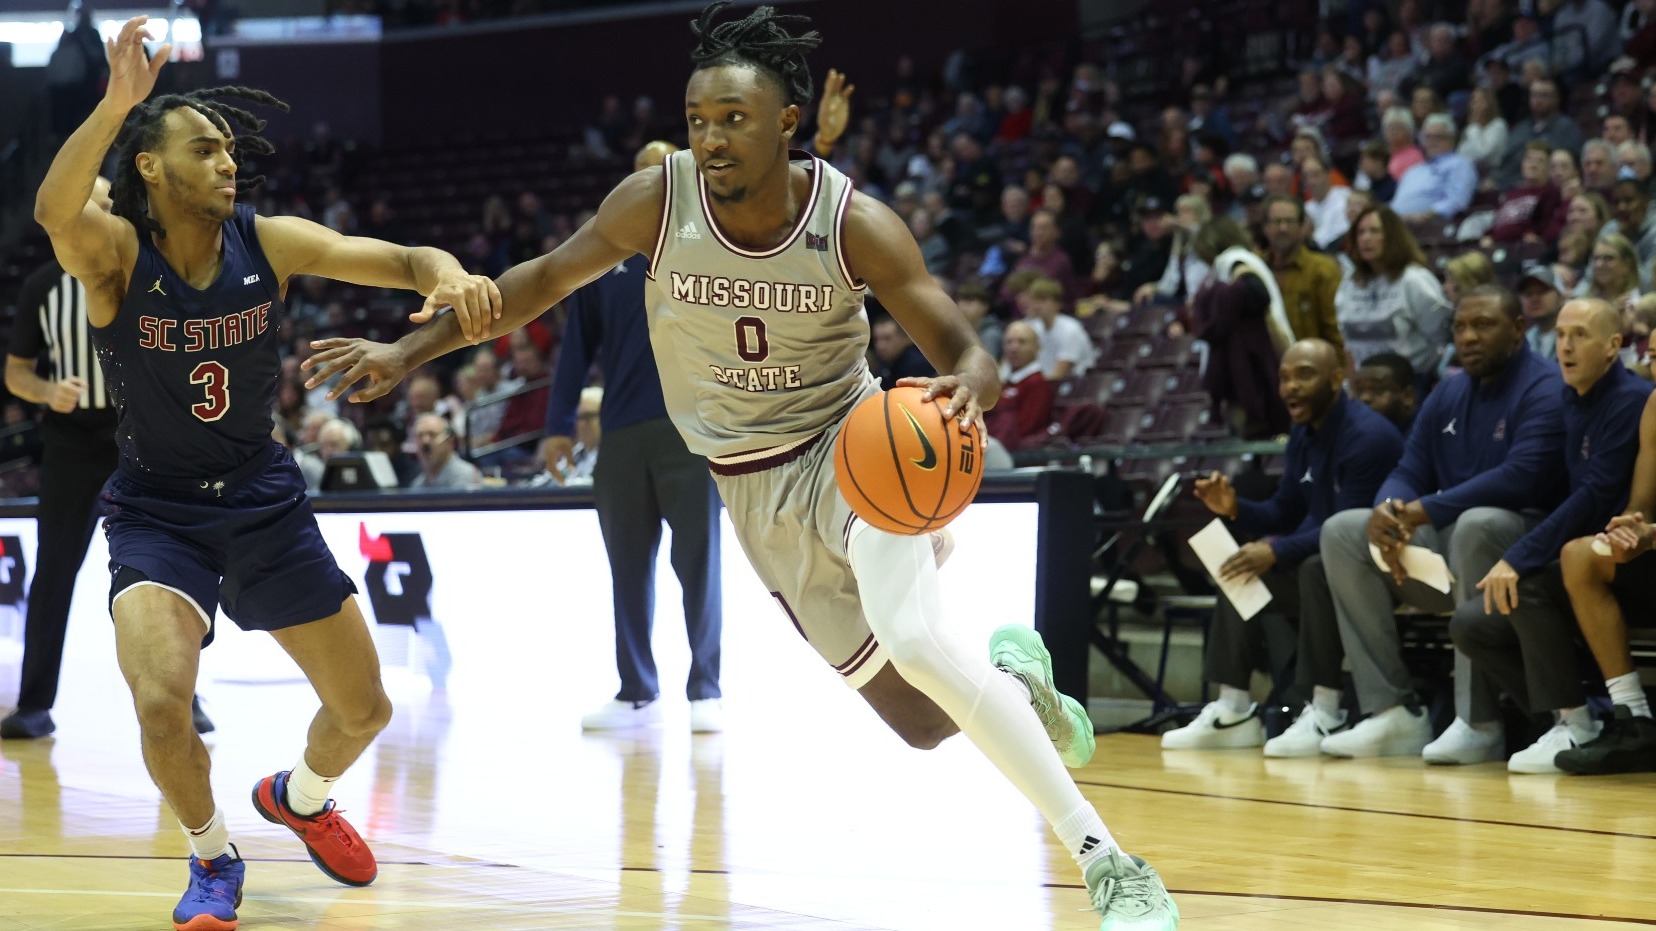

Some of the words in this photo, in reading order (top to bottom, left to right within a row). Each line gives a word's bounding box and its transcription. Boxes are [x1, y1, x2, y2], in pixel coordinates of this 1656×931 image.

[675, 231, 701, 240] adidas
[671, 271, 834, 313] MISSOURI
[139, 315, 177, 352] SC
[184, 301, 272, 352] STATE
[733, 315, 770, 363] 0
[189, 360, 230, 422] 3
[709, 364, 802, 392] STATE
[957, 411, 974, 475] ELI
